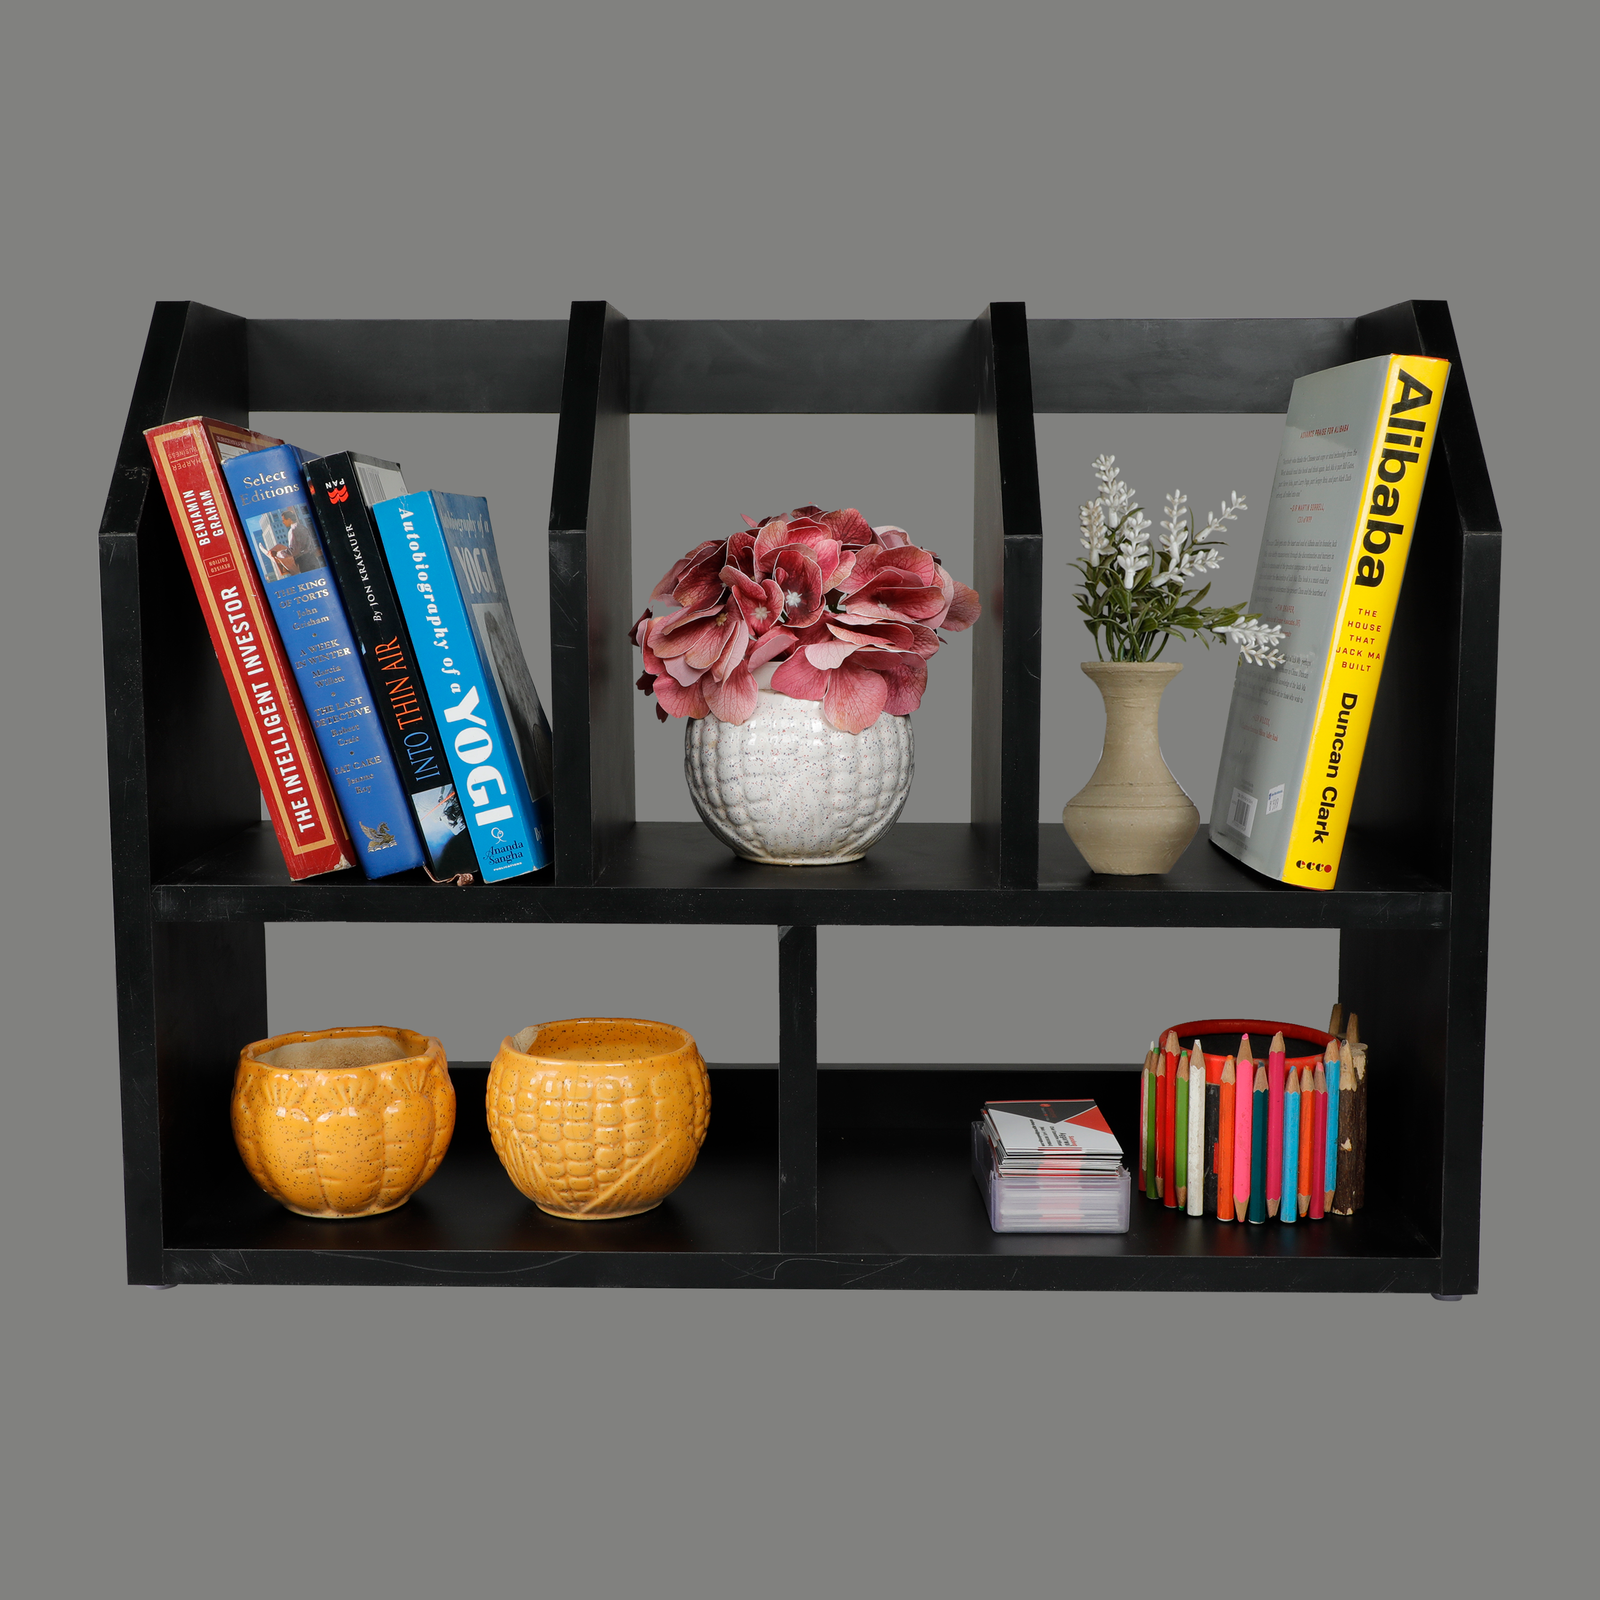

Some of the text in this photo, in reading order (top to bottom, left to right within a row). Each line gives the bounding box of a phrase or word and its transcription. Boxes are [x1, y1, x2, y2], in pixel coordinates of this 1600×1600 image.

[1300, 429, 1315, 439] ADVANCE
[1315, 427, 1327, 437] PRAISE
[1334, 424, 1350, 434] ALIBABA
[167, 446, 198, 461] BUSINESS
[171, 458, 203, 471] HARPER
[243, 470, 287, 489] Select
[325, 478, 346, 489] PAN
[1354, 368, 1433, 588] Alibaba
[240, 482, 300, 507] Editions
[182, 489, 211, 546] BENJAMIN
[199, 489, 224, 537] GRAHAM
[208, 556, 229, 567] EDITION
[210, 562, 231, 574] REVISED
[453, 545, 497, 594] YOGI
[345, 523, 383, 622] By JON KRAKAUER
[274, 577, 327, 599] THE KING
[279, 588, 330, 609] OF TORTS
[398, 506, 462, 694] Autobiography of a
[296, 607, 318, 619] John
[1358, 608, 1378, 618] THE
[292, 615, 330, 631] Grisham
[1347, 620, 1382, 632] HOUSE
[299, 638, 340, 657] A WEEK
[1349, 634, 1376, 645] THAT
[295, 647, 352, 670] IN WINTER
[1336, 646, 1381, 660] JACK MA
[311, 665, 342, 679] Marcia
[1341, 661, 1371, 672] BUILT
[220, 585, 315, 833] THE INTELLIGENT INVESTOR
[314, 696, 363, 717] THE LAST
[374, 635, 441, 781] INTO THIN AIR
[314, 705, 372, 729] DETECTIVE
[330, 724, 360, 738] Robert
[1326, 692, 1358, 779] Duncan
[337, 735, 360, 747] Crais
[333, 755, 382, 775] EAT CAKE
[443, 685, 514, 827] YOGI
[346, 773, 375, 787] Jeanne
[354, 785, 372, 795] Ray
[1312, 786, 1338, 844] Clark
[483, 840, 524, 860] Ananda
[489, 851, 524, 866] Sangha
